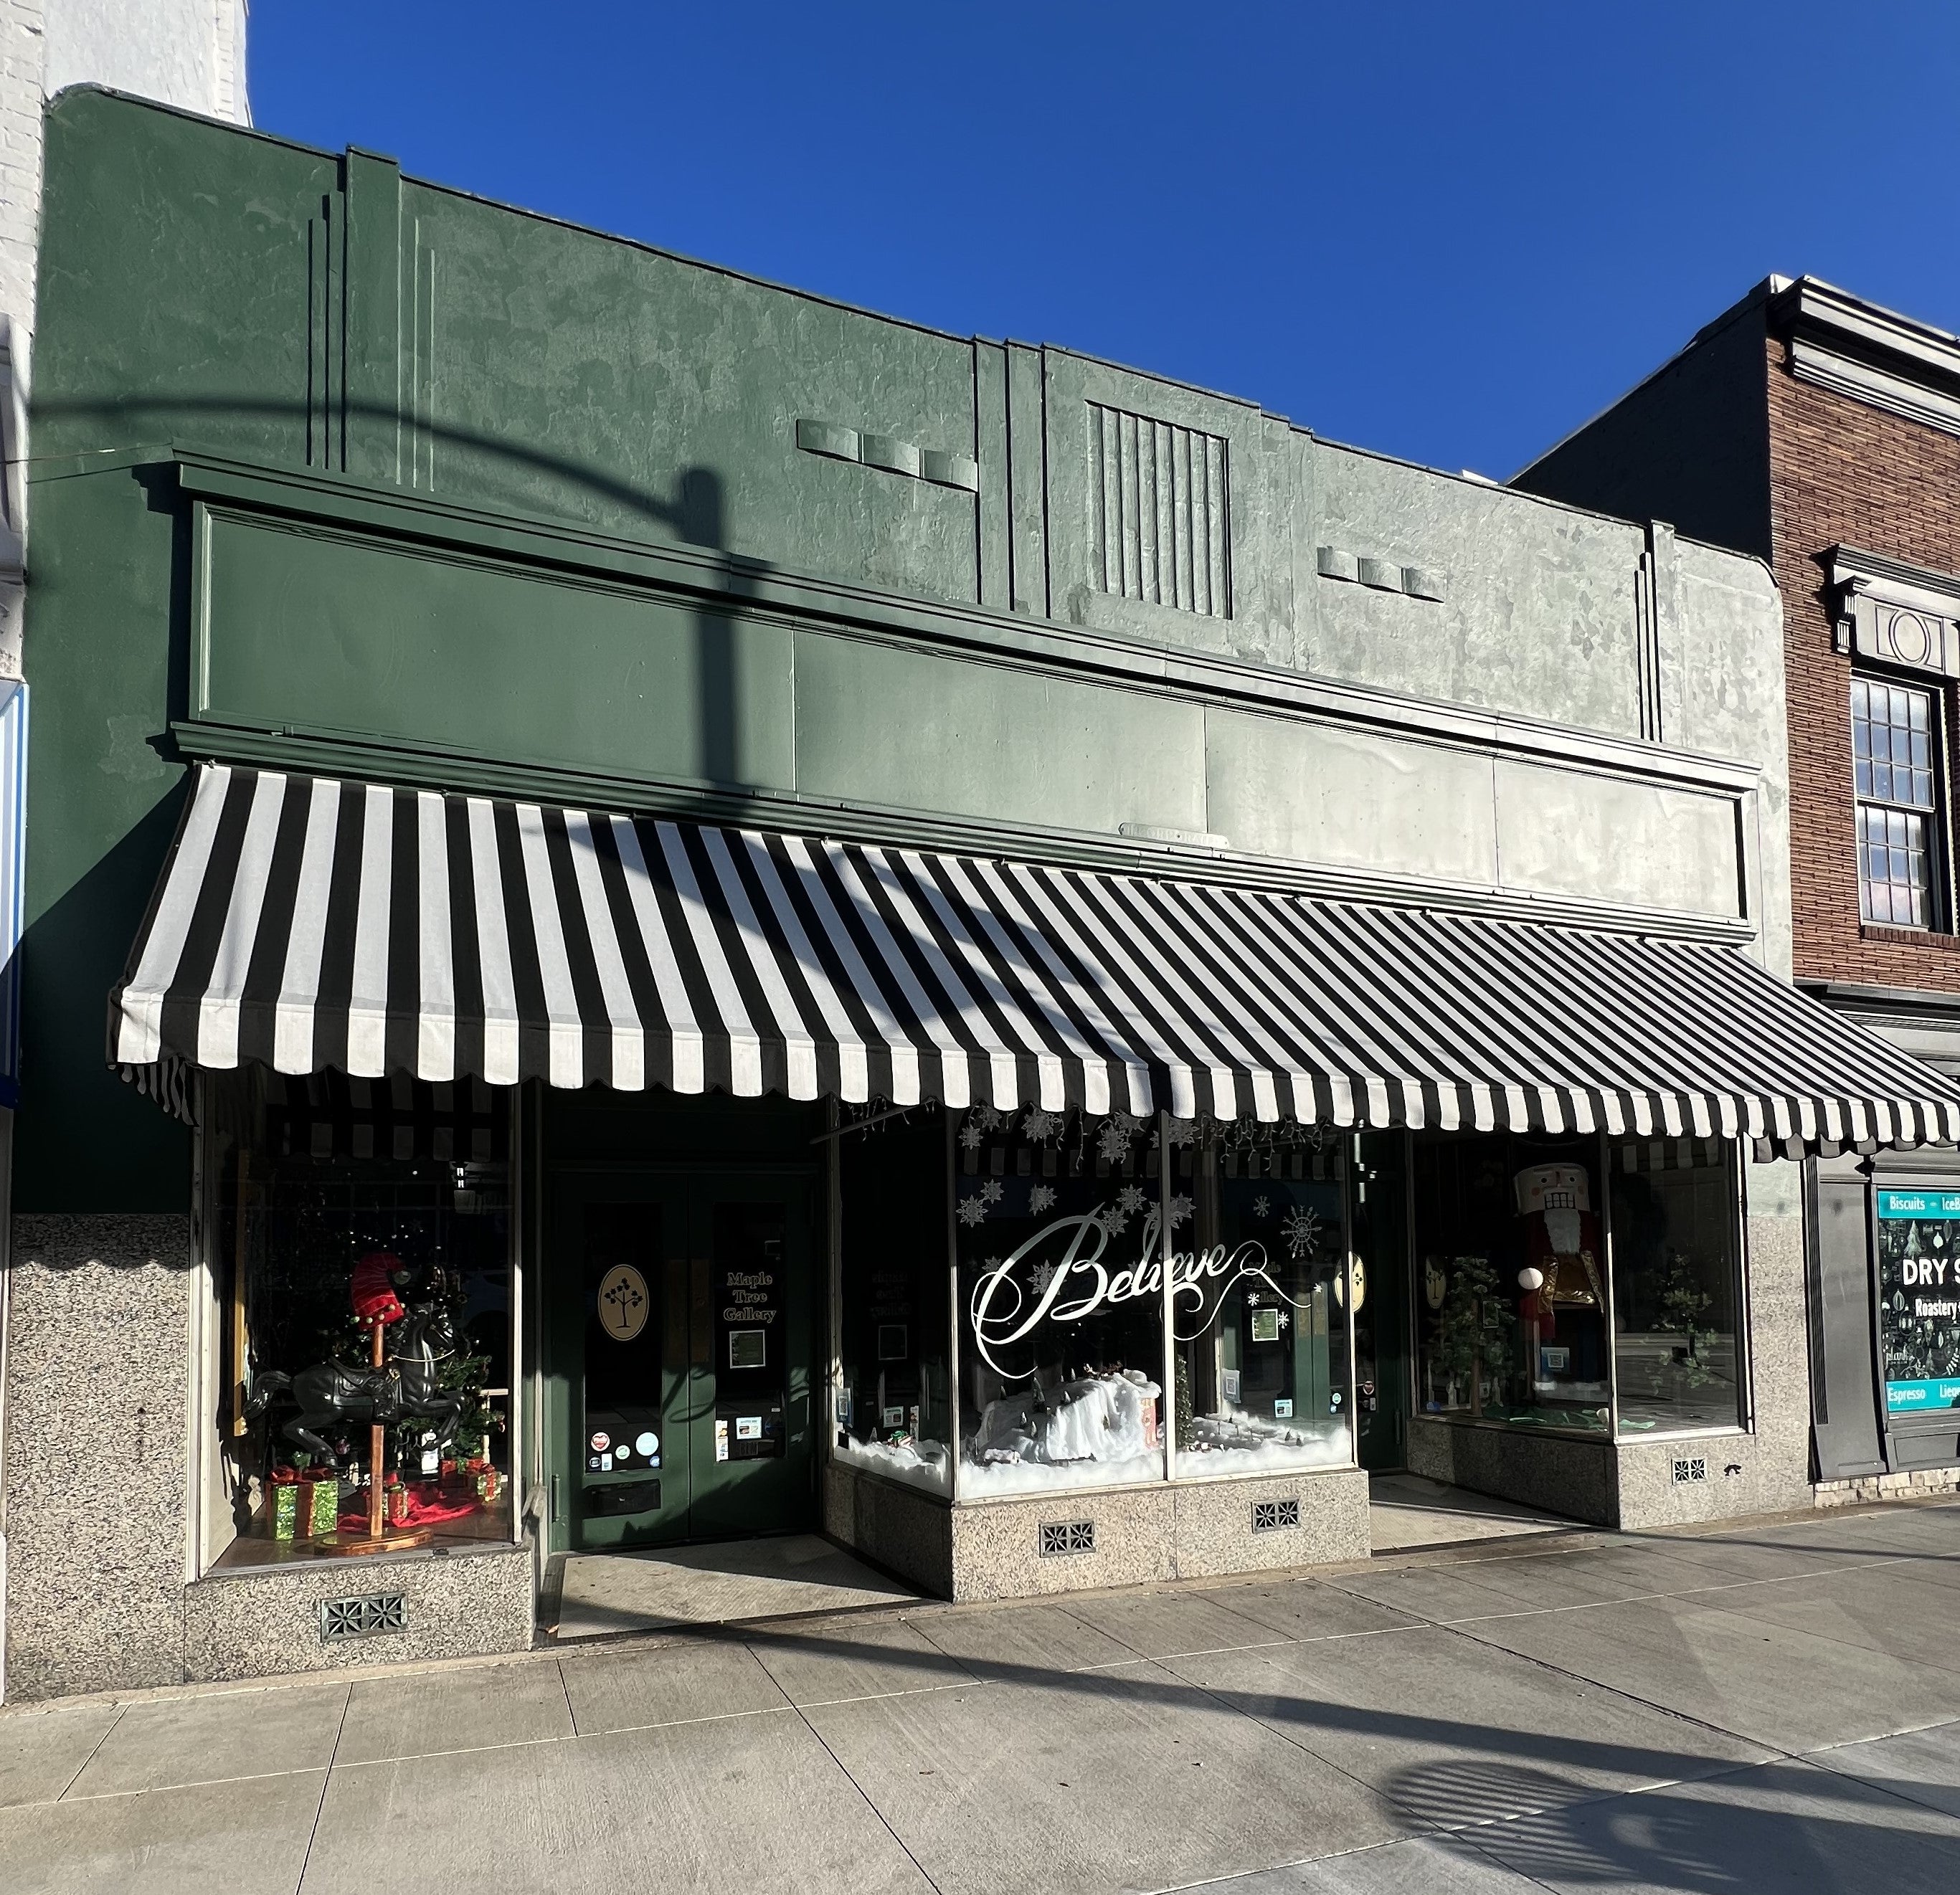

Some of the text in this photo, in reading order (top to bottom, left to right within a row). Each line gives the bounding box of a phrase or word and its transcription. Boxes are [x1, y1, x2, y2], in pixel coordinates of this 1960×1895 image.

[1890, 1196, 1926, 1211] Biscuits
[726, 1272, 773, 1289] Maple
[1902, 1258, 1949, 1286] DRY
[732, 1290, 767, 1303] Tree
[971, 1202, 1311, 1379] Believe
[723, 1307, 777, 1324] Gallery
[1915, 1298, 1957, 1320] Roastery
[1888, 1387, 1926, 1404] Espresso
